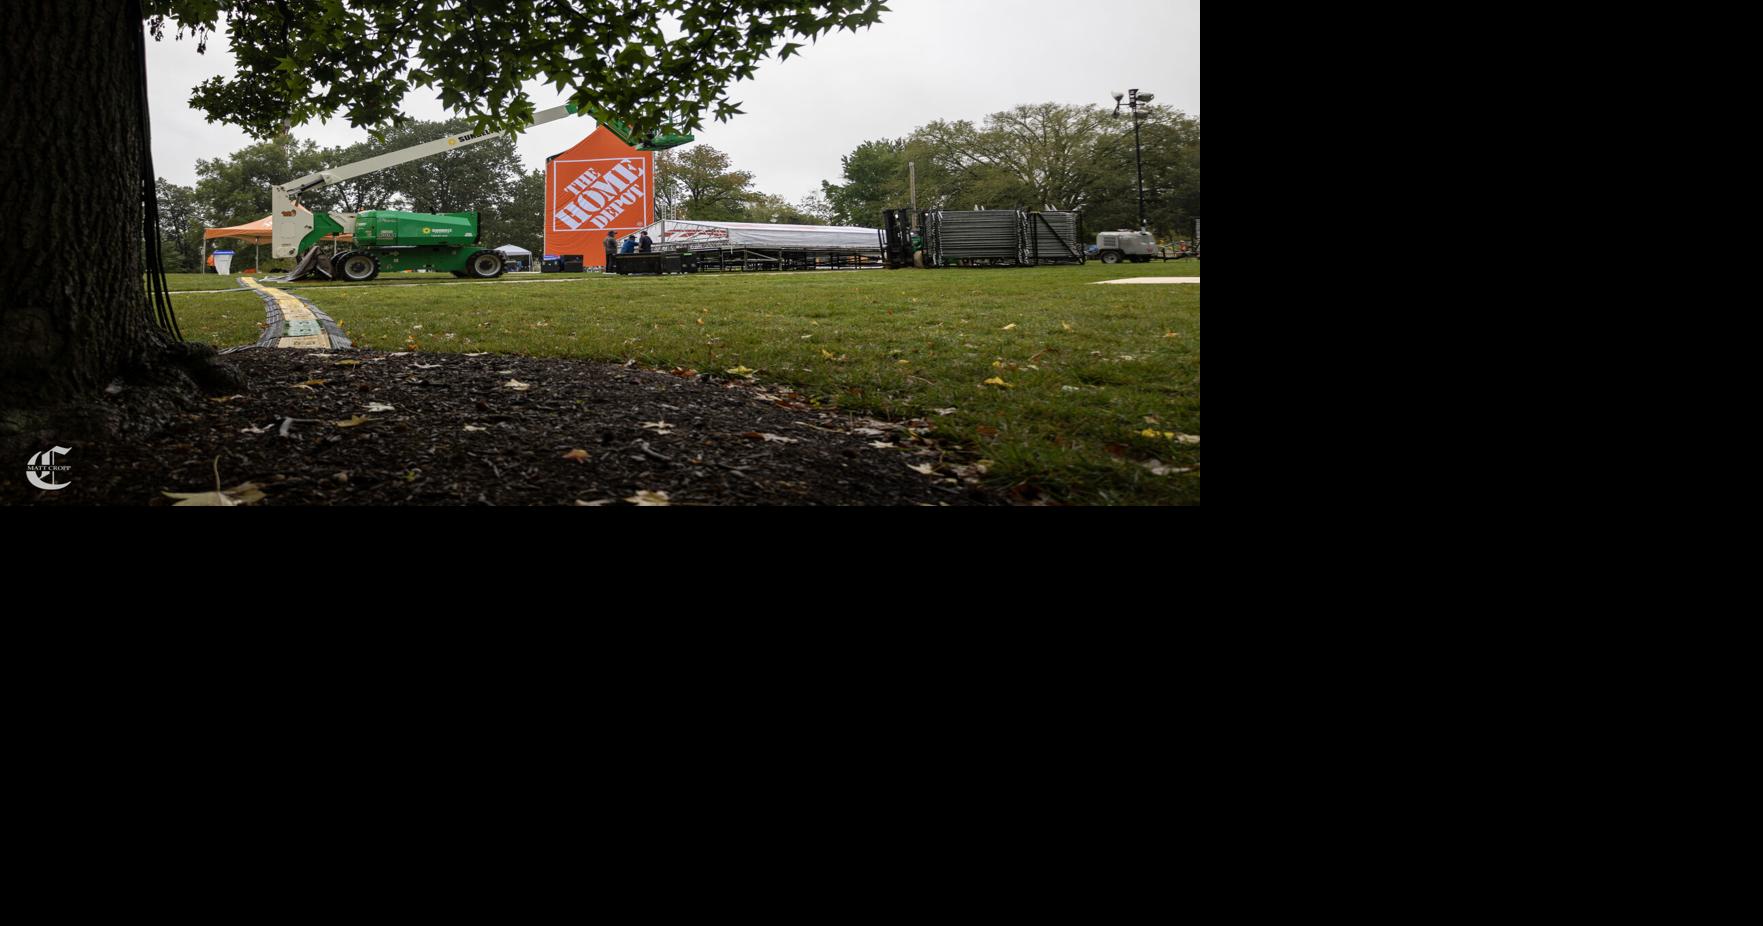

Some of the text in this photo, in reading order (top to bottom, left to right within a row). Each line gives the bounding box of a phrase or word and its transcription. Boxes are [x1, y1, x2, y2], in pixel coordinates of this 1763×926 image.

[555, 158, 644, 230] HOME
[564, 167, 601, 195] THE
[590, 183, 644, 229] DEPOT
